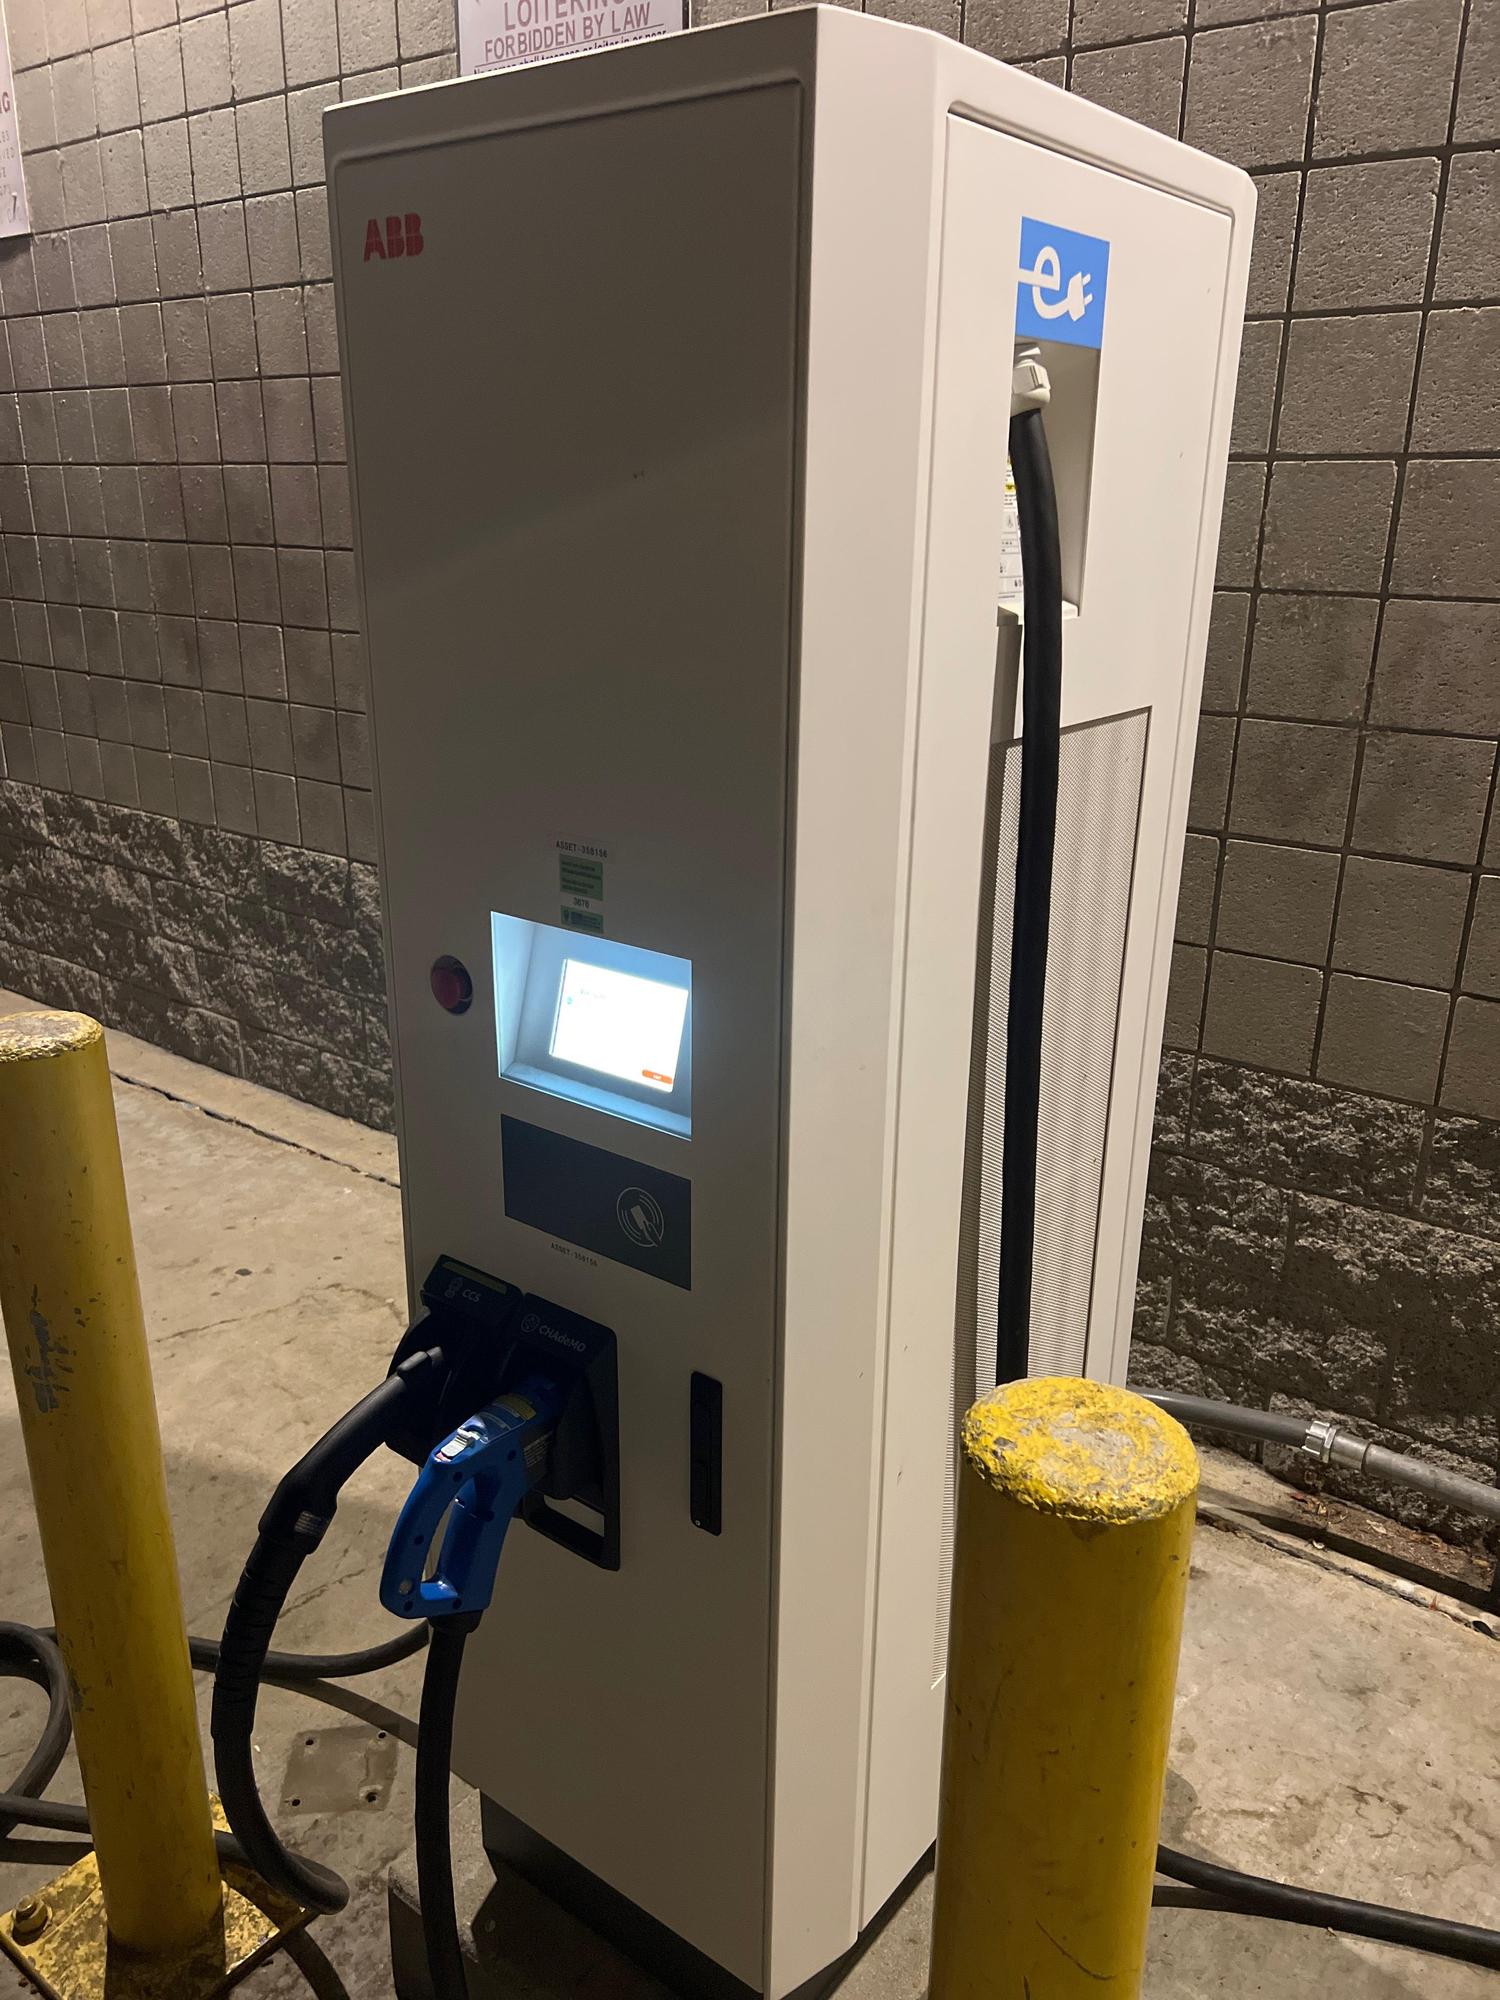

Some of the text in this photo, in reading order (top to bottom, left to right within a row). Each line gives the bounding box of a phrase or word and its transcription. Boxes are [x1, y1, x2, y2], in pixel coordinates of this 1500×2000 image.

[504, 0, 625, 31] LOITER
[485, 2, 651, 63] FORBIDDEN BY LAW
[363, 212, 425, 263] ABB
[462, 1289, 482, 1303] CCS
[538, 1324, 587, 1353] CHAdeMO
